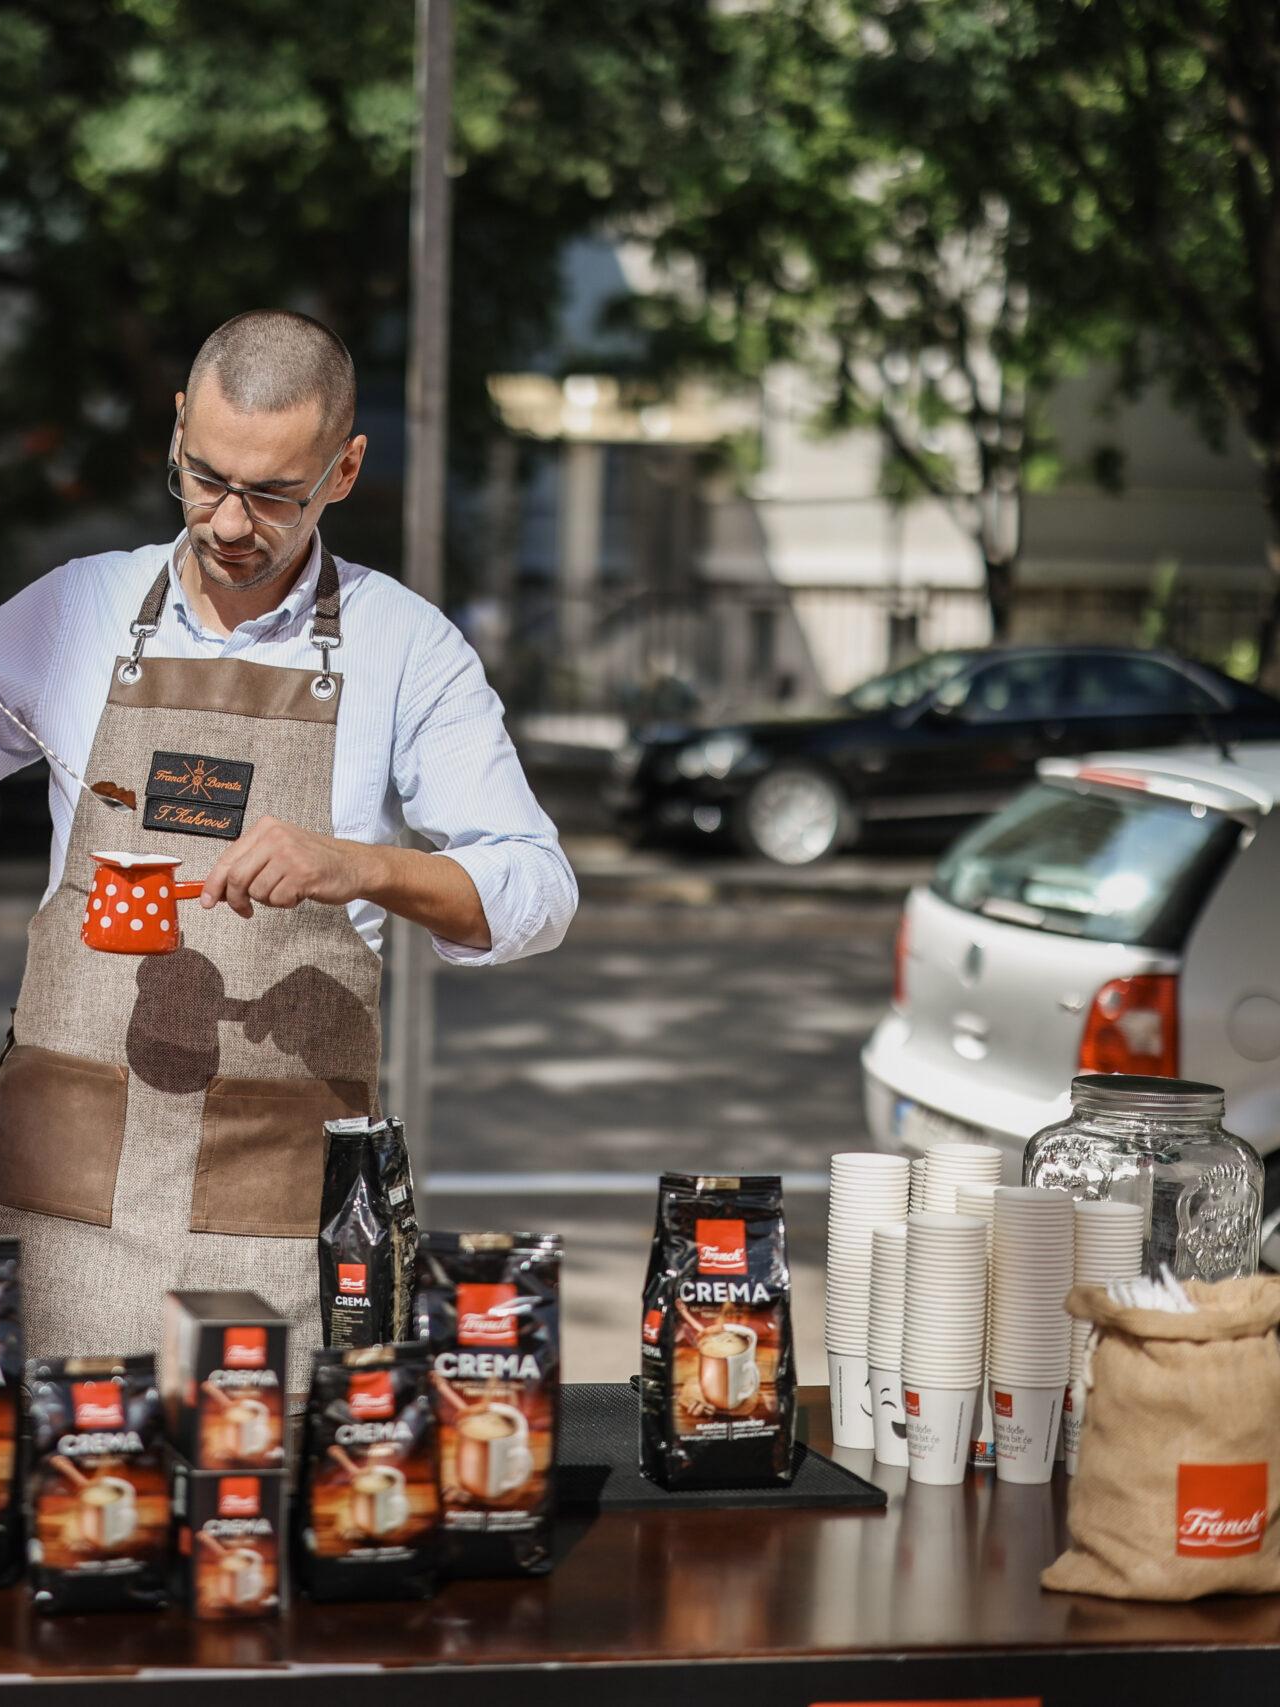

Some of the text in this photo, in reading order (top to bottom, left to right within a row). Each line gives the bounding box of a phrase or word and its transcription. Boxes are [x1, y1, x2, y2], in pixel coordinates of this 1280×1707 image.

[205, 776, 242, 791] Barista
[335, 1295, 372, 1307] CREMA
[679, 1282, 771, 1303] CREMA
[434, 1352, 542, 1379] CREMA
[57, 1431, 145, 1456] CREMA
[335, 1421, 415, 1446] CREMA
[1179, 1507, 1266, 1536] Franck
